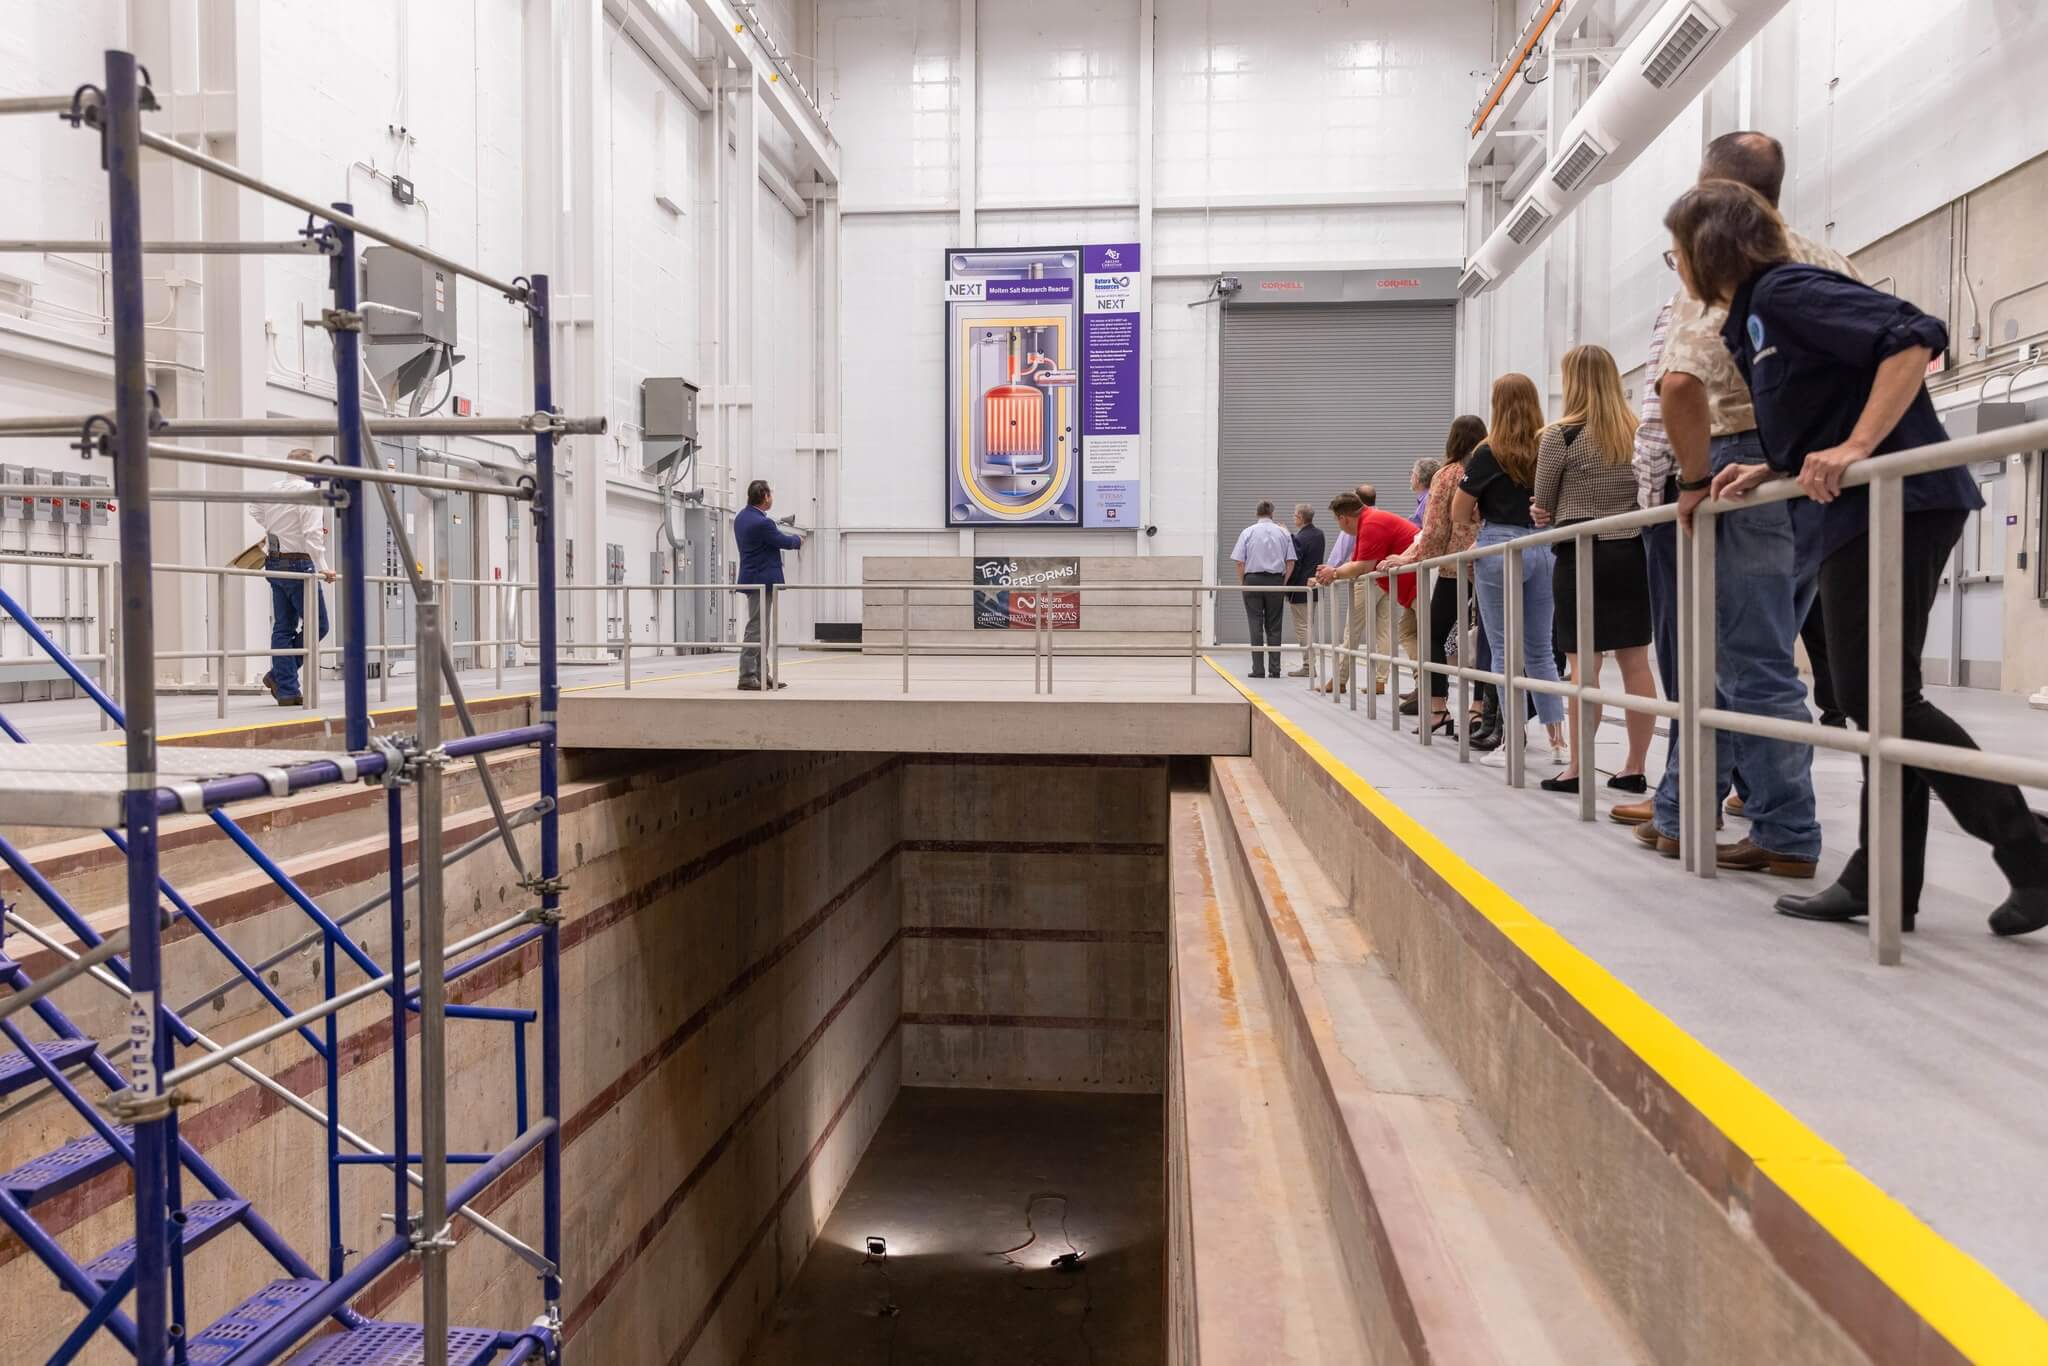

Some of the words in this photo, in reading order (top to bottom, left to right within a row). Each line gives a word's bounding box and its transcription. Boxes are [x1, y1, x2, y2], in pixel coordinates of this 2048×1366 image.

[1261, 281, 1303, 289] CORNELL
[1377, 279, 1420, 288] CORNELL
[949, 284, 983, 296] NEXT
[989, 286, 1009, 294] Molten
[1009, 286, 1021, 294] Salt
[1021, 285, 1047, 293] Research
[1047, 285, 1070, 293] Reactor
[1098, 299, 1125, 309] NEXT
[976, 561, 1018, 579] TEXAS
[999, 561, 1077, 586] PERFORMS!
[1046, 611, 1077, 620] EXAS
